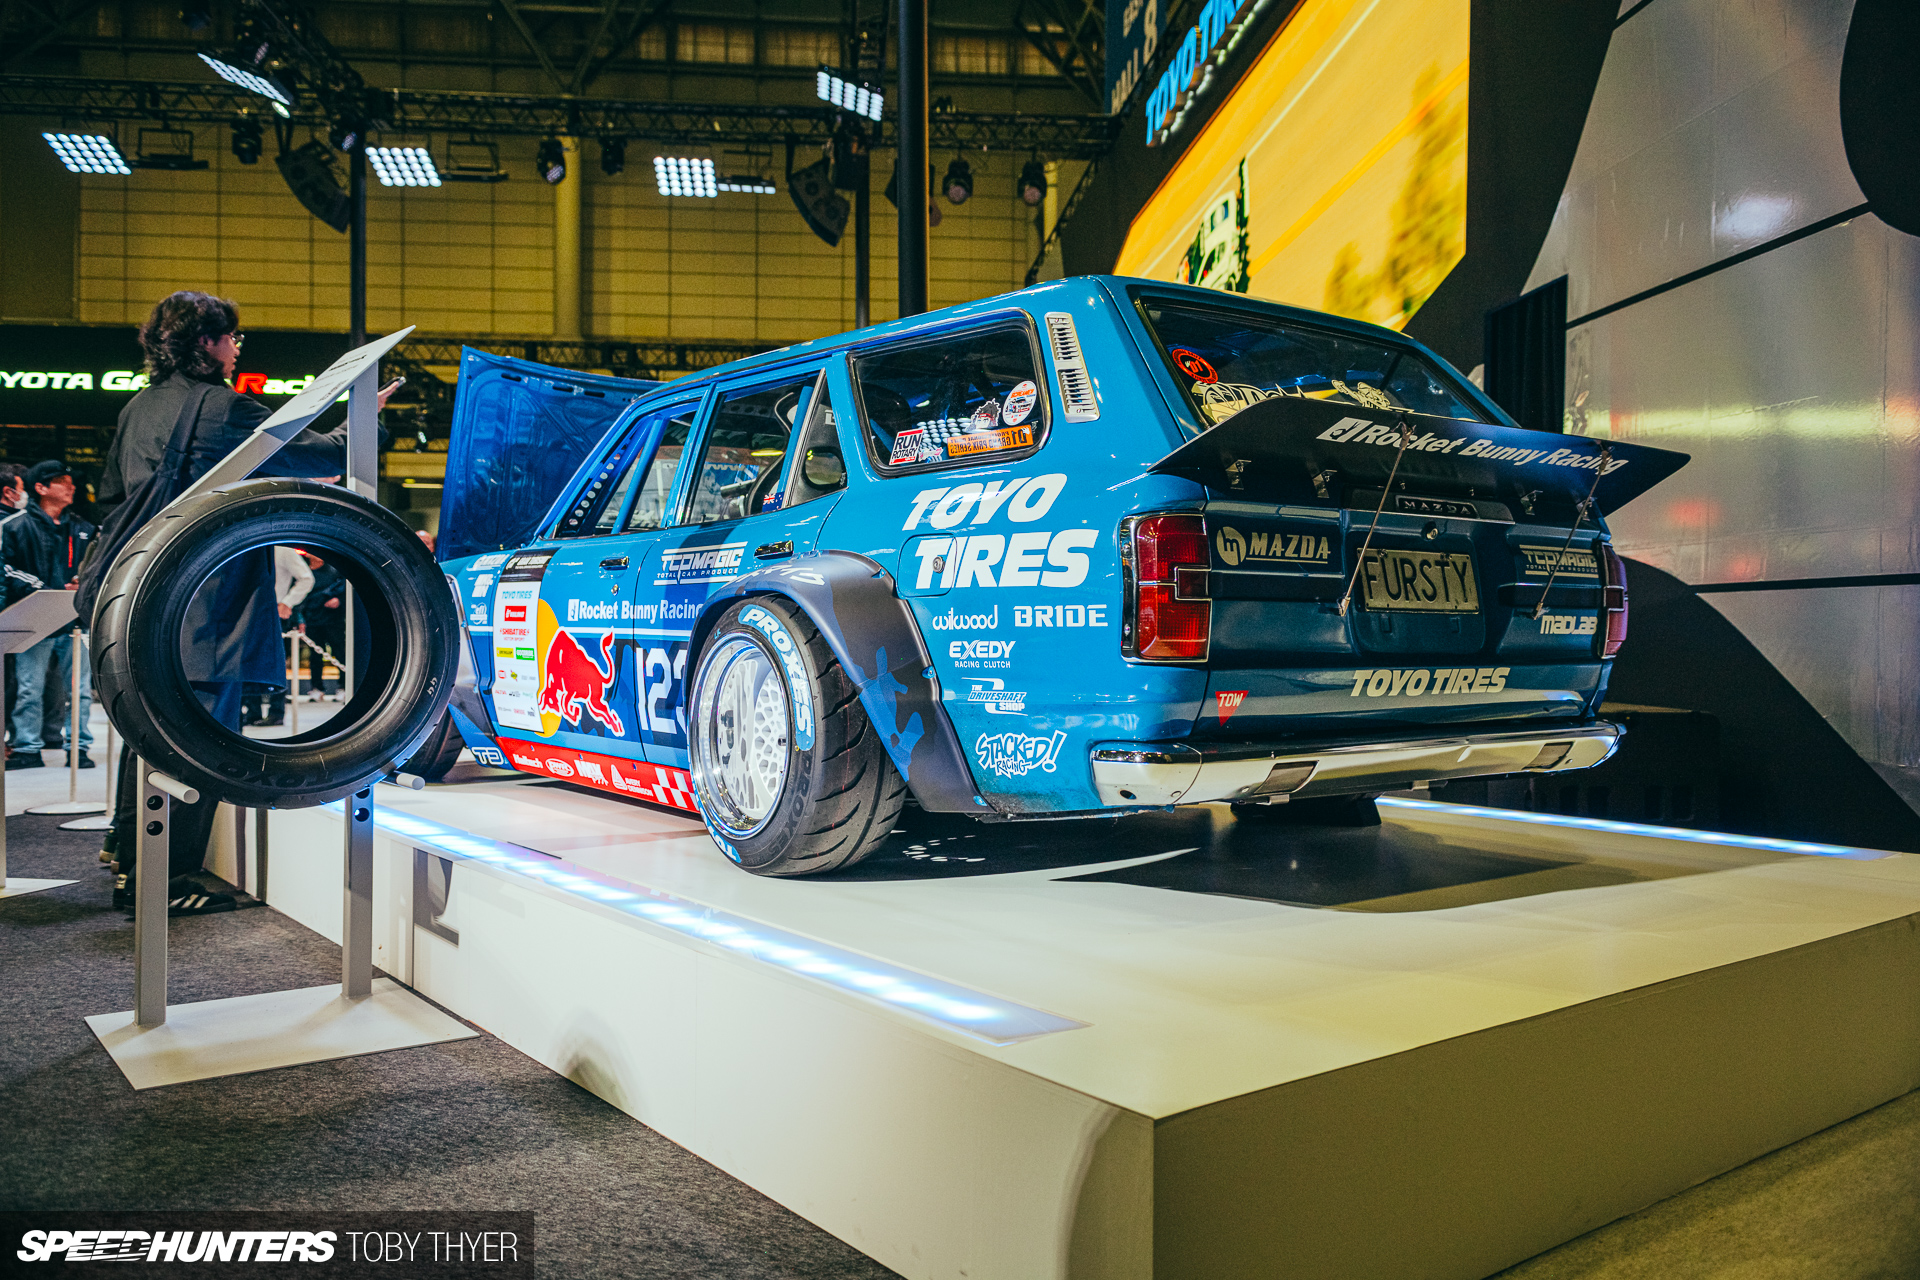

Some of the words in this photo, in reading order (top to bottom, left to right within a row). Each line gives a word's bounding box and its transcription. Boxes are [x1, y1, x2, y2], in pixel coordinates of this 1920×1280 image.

[1146, 27, 1197, 146] TOYO
[0, 371, 94, 391] YOTA
[891, 446, 918, 459] ROTARY
[894, 434, 922, 450] RUN
[1354, 425, 1467, 454] Rocket
[1458, 439, 1546, 466] Bunny
[1539, 448, 1629, 476] Racing
[902, 473, 1068, 531] TOYO
[1404, 500, 1472, 515] MAZDA
[1250, 532, 1331, 559] MAZDA
[914, 529, 1100, 590] TIRES
[700, 568, 739, 576] PRODUCE
[1363, 556, 1469, 604] FURSTY
[579, 601, 618, 619] Rocket
[621, 601, 658, 624] Bunny
[932, 605, 998, 630] wilwood
[1013, 604, 1109, 627] BRIDE
[949, 640, 1016, 659] EXEDY
[742, 608, 812, 737] PROXES
[955, 660, 980, 668] RACING
[983, 660, 1011, 668] CLUTCH
[1350, 669, 1431, 697] TOYO
[1431, 667, 1510, 695] TIRES
[968, 691, 1027, 702] DRIVESHAFT
[999, 702, 1025, 711] SHOP
[1219, 692, 1244, 707] TOW
[975, 730, 1068, 773] STACKED!
